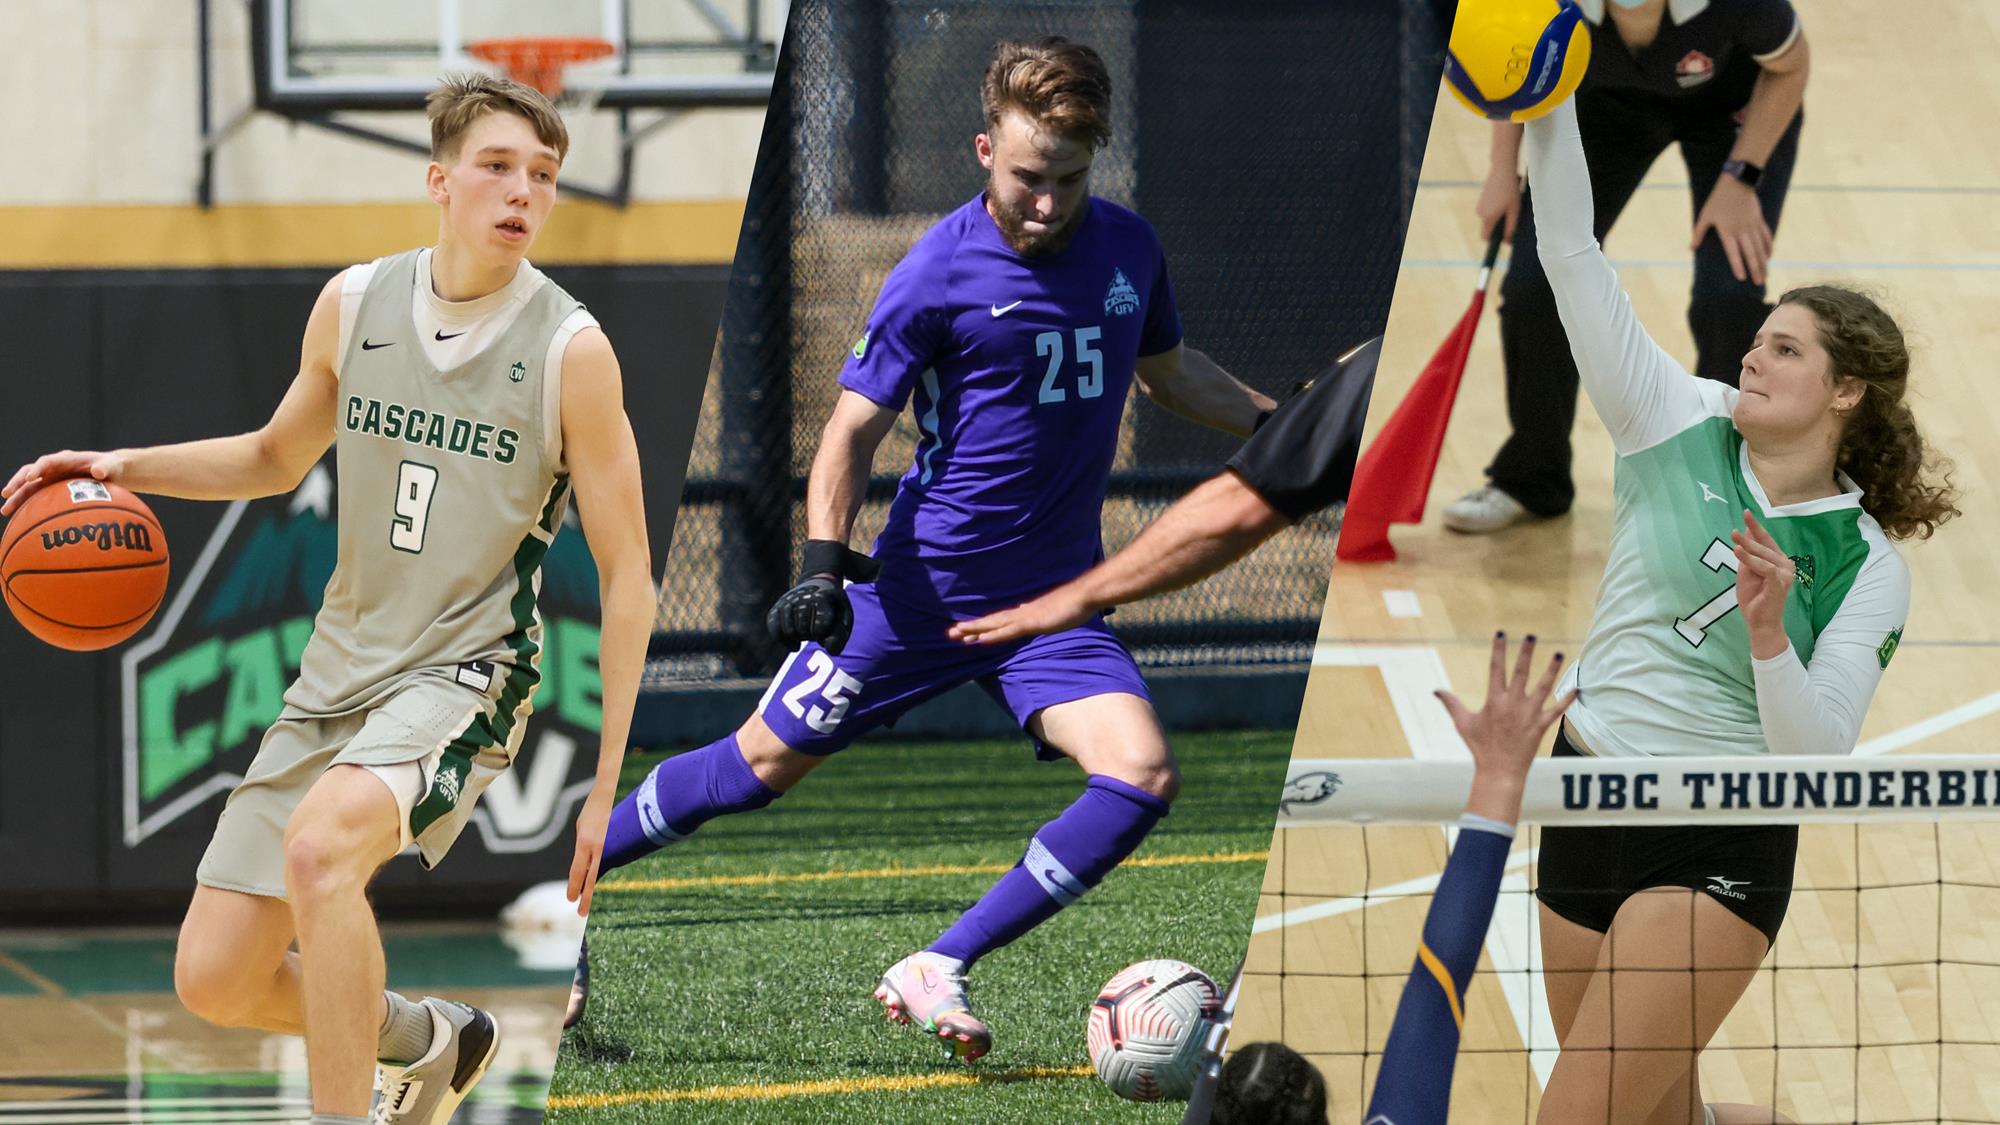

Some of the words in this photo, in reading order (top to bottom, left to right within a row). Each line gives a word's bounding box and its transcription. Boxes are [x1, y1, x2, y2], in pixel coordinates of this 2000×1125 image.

[1035, 325, 1104, 405] 25
[345, 395, 521, 466] CASCADES
[41, 521, 153, 553] Wilson
[389, 459, 439, 555] 9
[1672, 536, 1738, 650] 7
[781, 649, 864, 734] 25
[1561, 773, 1659, 811] UBC
